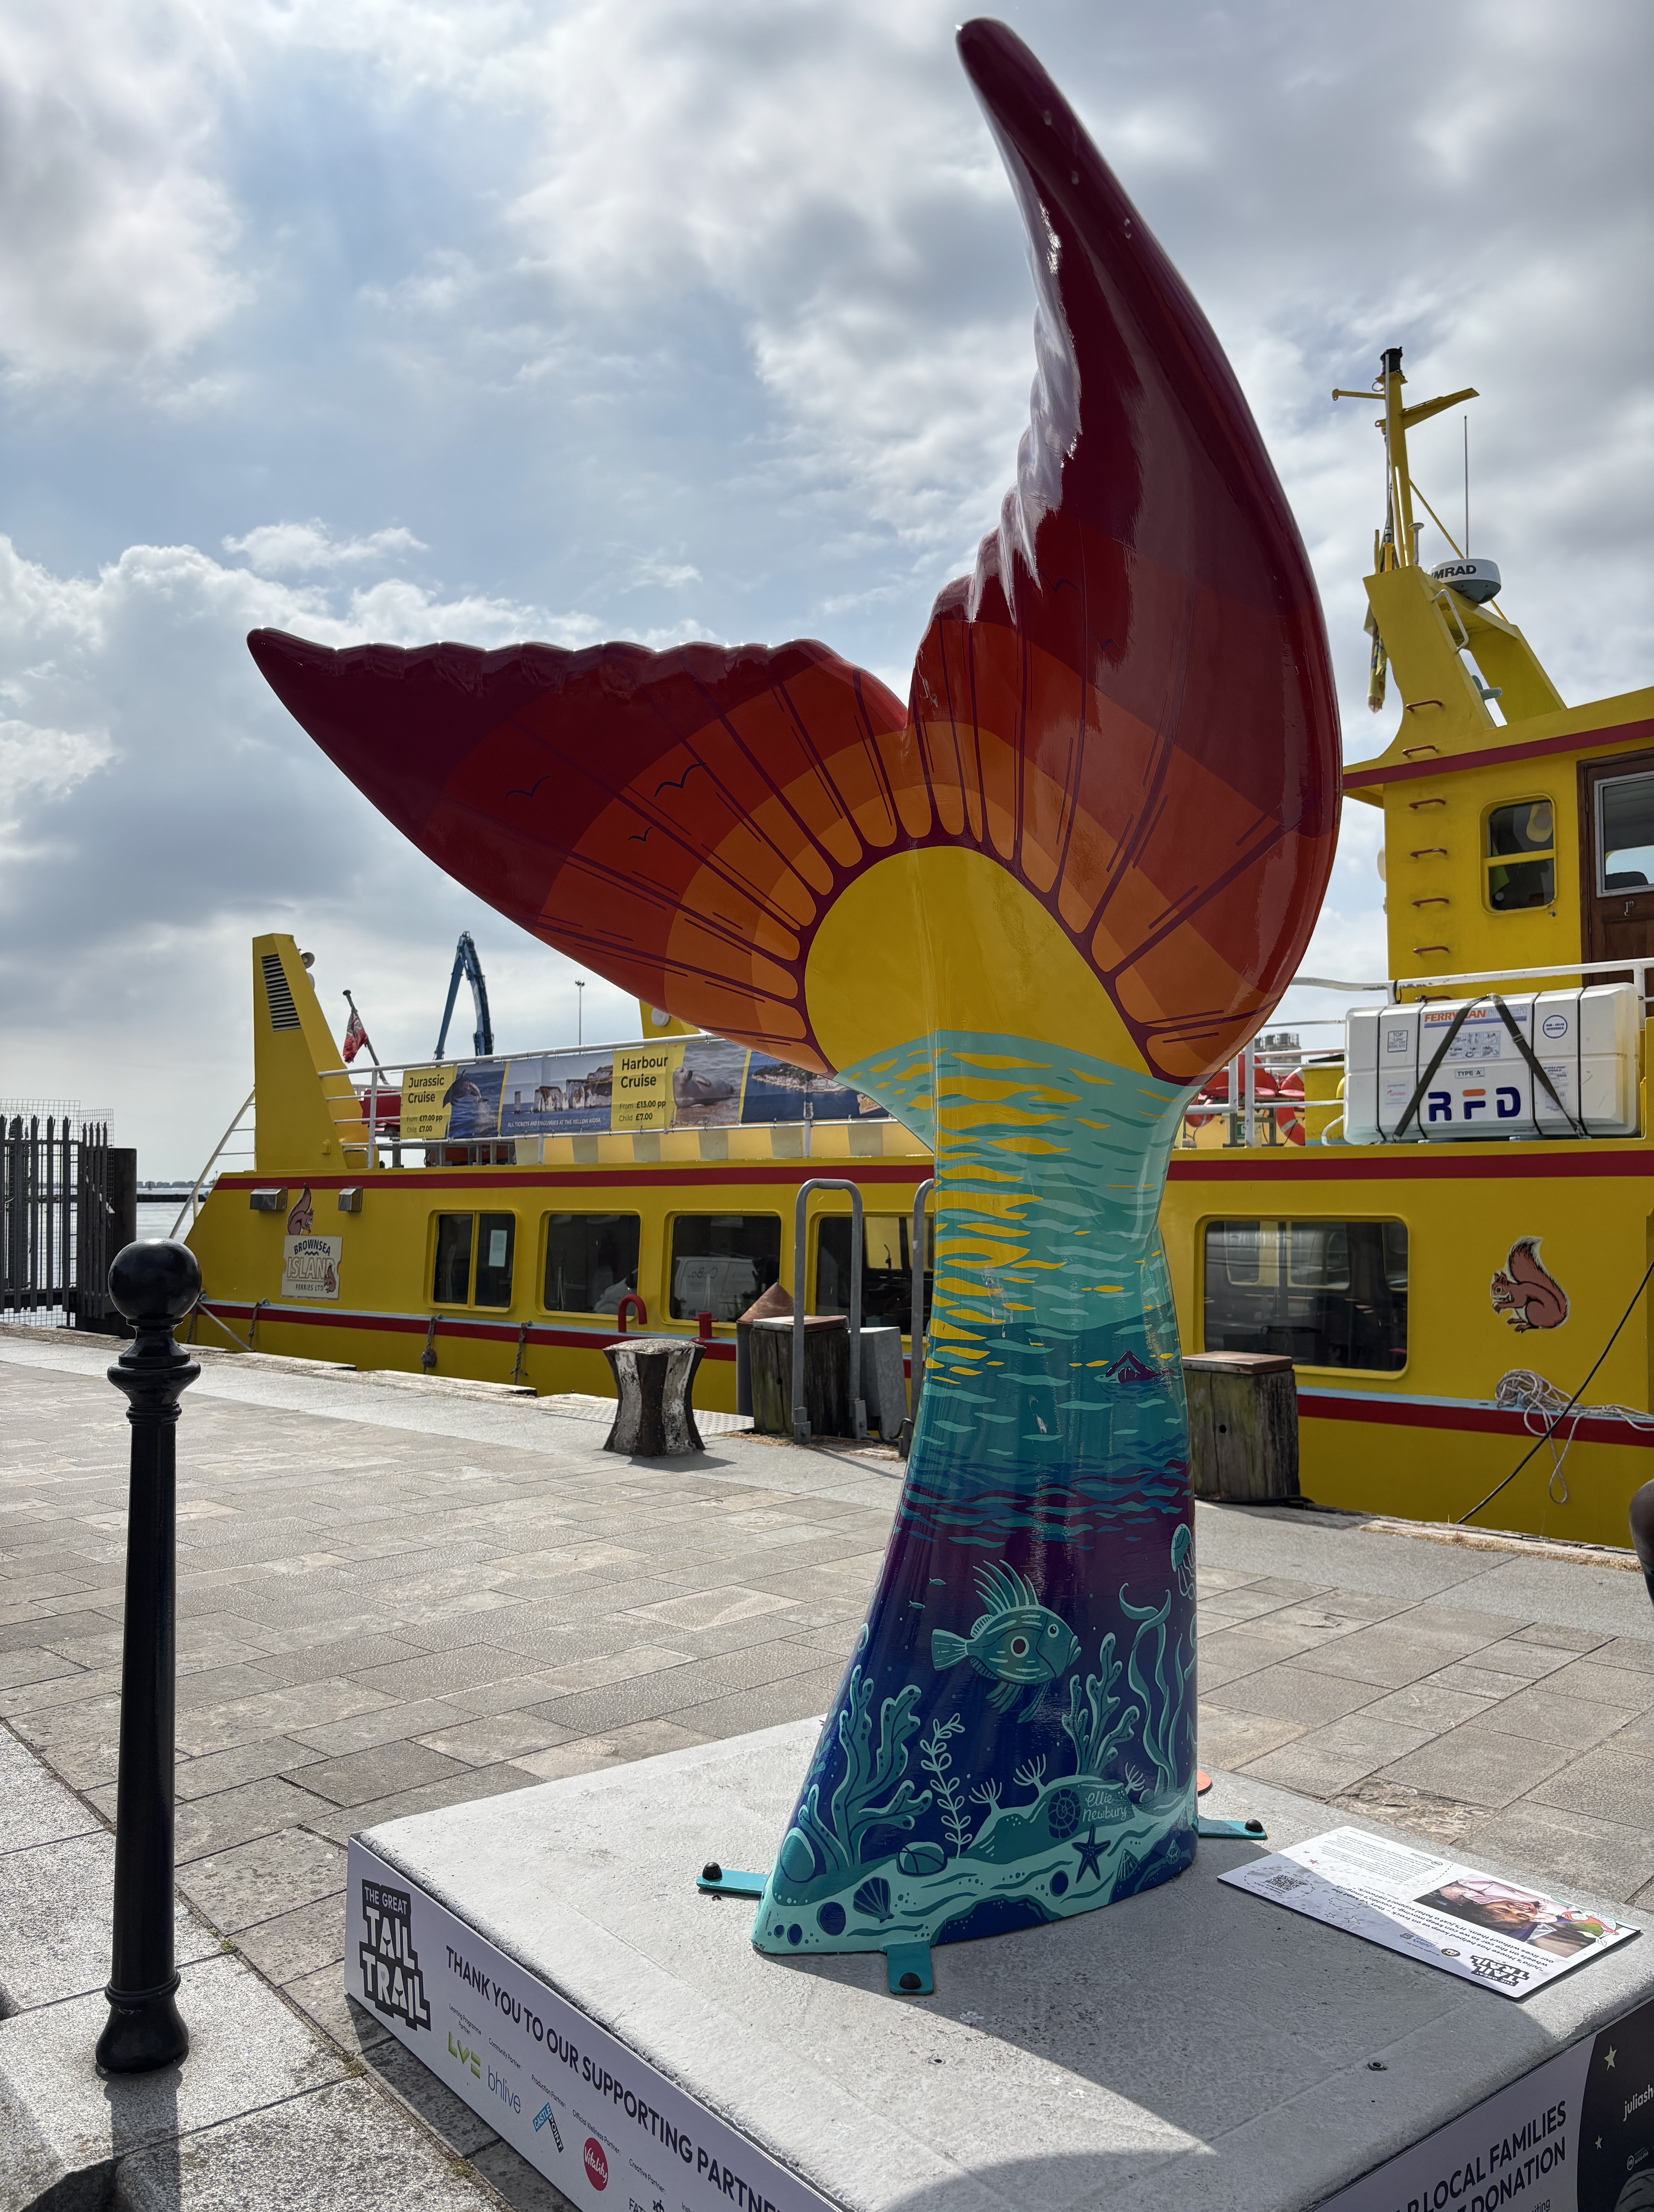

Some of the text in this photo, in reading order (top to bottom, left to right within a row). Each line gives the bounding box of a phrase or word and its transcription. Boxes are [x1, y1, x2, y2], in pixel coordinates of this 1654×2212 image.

[1431, 565, 1476, 579] MRAD
[1424, 1010, 1486, 1022] FERRYAN
[622, 1056, 668, 1070] Harbour
[408, 1073, 444, 1088] Jurassic
[621, 1073, 657, 1088] Cruise
[408, 1091, 435, 1103] Cruise
[636, 1100, 656, 1108] £13.00
[1428, 1087, 1521, 1121] RFD
[636, 1113, 653, 1121] £7.00
[294, 1239, 331, 1257] BROWNSEA
[287, 1257, 335, 1280] ISLAND
[364, 1886, 407, 1915] THE GREAT
[366, 1906, 415, 1970] TAIL
[1474, 1957, 1526, 1979] TRAIL
[1476, 1972, 1498, 1980] GREAT
[1477, 1965, 1515, 1982] TAIL
[362, 1950, 427, 2021] TRAIL
[450, 2003, 481, 2035] Learning Programme
[459, 2021, 471, 2037] Partner:
[446, 1945, 490, 2001] THANK
[492, 1982, 521, 2024] YOU
[523, 2007, 544, 2042] TO
[546, 2028, 579, 2074] OUR
[582, 2056, 693, 2164] SUPPORTING
[489, 2038, 522, 2071] Community Partner:
[488, 2065, 521, 2114] bhlive
[531, 2075, 566, 2109] Production Partner:
[1623, 2084, 1654, 2121] juliash
[534, 2104, 551, 2129] CASTLE
[549, 2113, 563, 2150] POINT
[573, 2109, 621, 2156] Official Wellness Partner:
[584, 2147, 607, 2183] Vitality
[1423, 2100, 1566, 2212] LOCAL FAMILIES
[629, 2159, 666, 2195] Creative Partner:
[1472, 2136, 1565, 2212] DONATION
